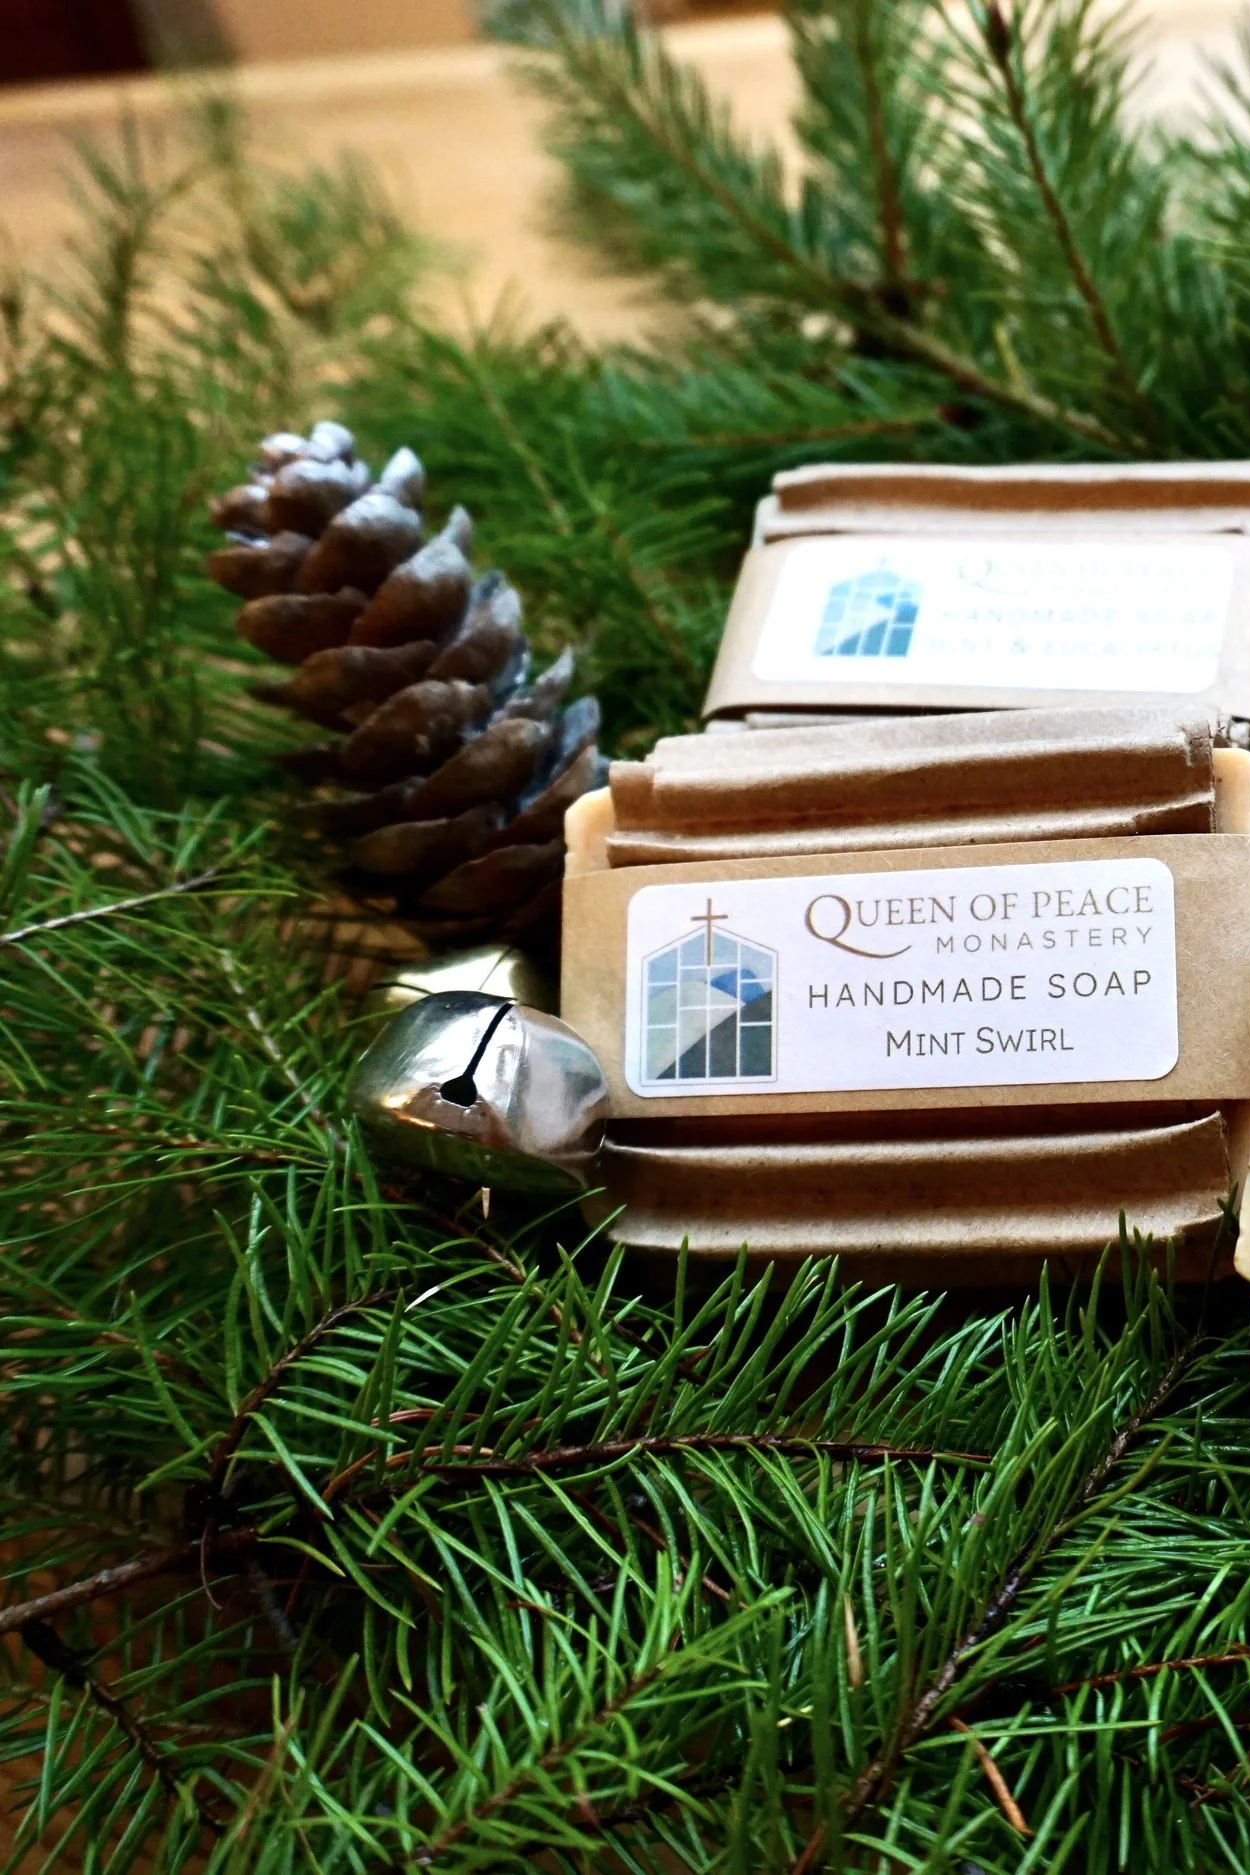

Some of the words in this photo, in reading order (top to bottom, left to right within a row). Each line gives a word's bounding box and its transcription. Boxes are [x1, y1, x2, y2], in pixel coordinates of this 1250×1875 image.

[804, 893, 955, 959] QUEEN
[970, 891, 1017, 921] OF
[1032, 885, 1154, 919] PEACE
[936, 926, 1153, 953] MONASTERY
[808, 974, 1027, 1008] HANDMADE
[1047, 969, 1152, 998] SOAP
[886, 1029, 965, 1056] MINT
[975, 1026, 1074, 1054] SWIRL
